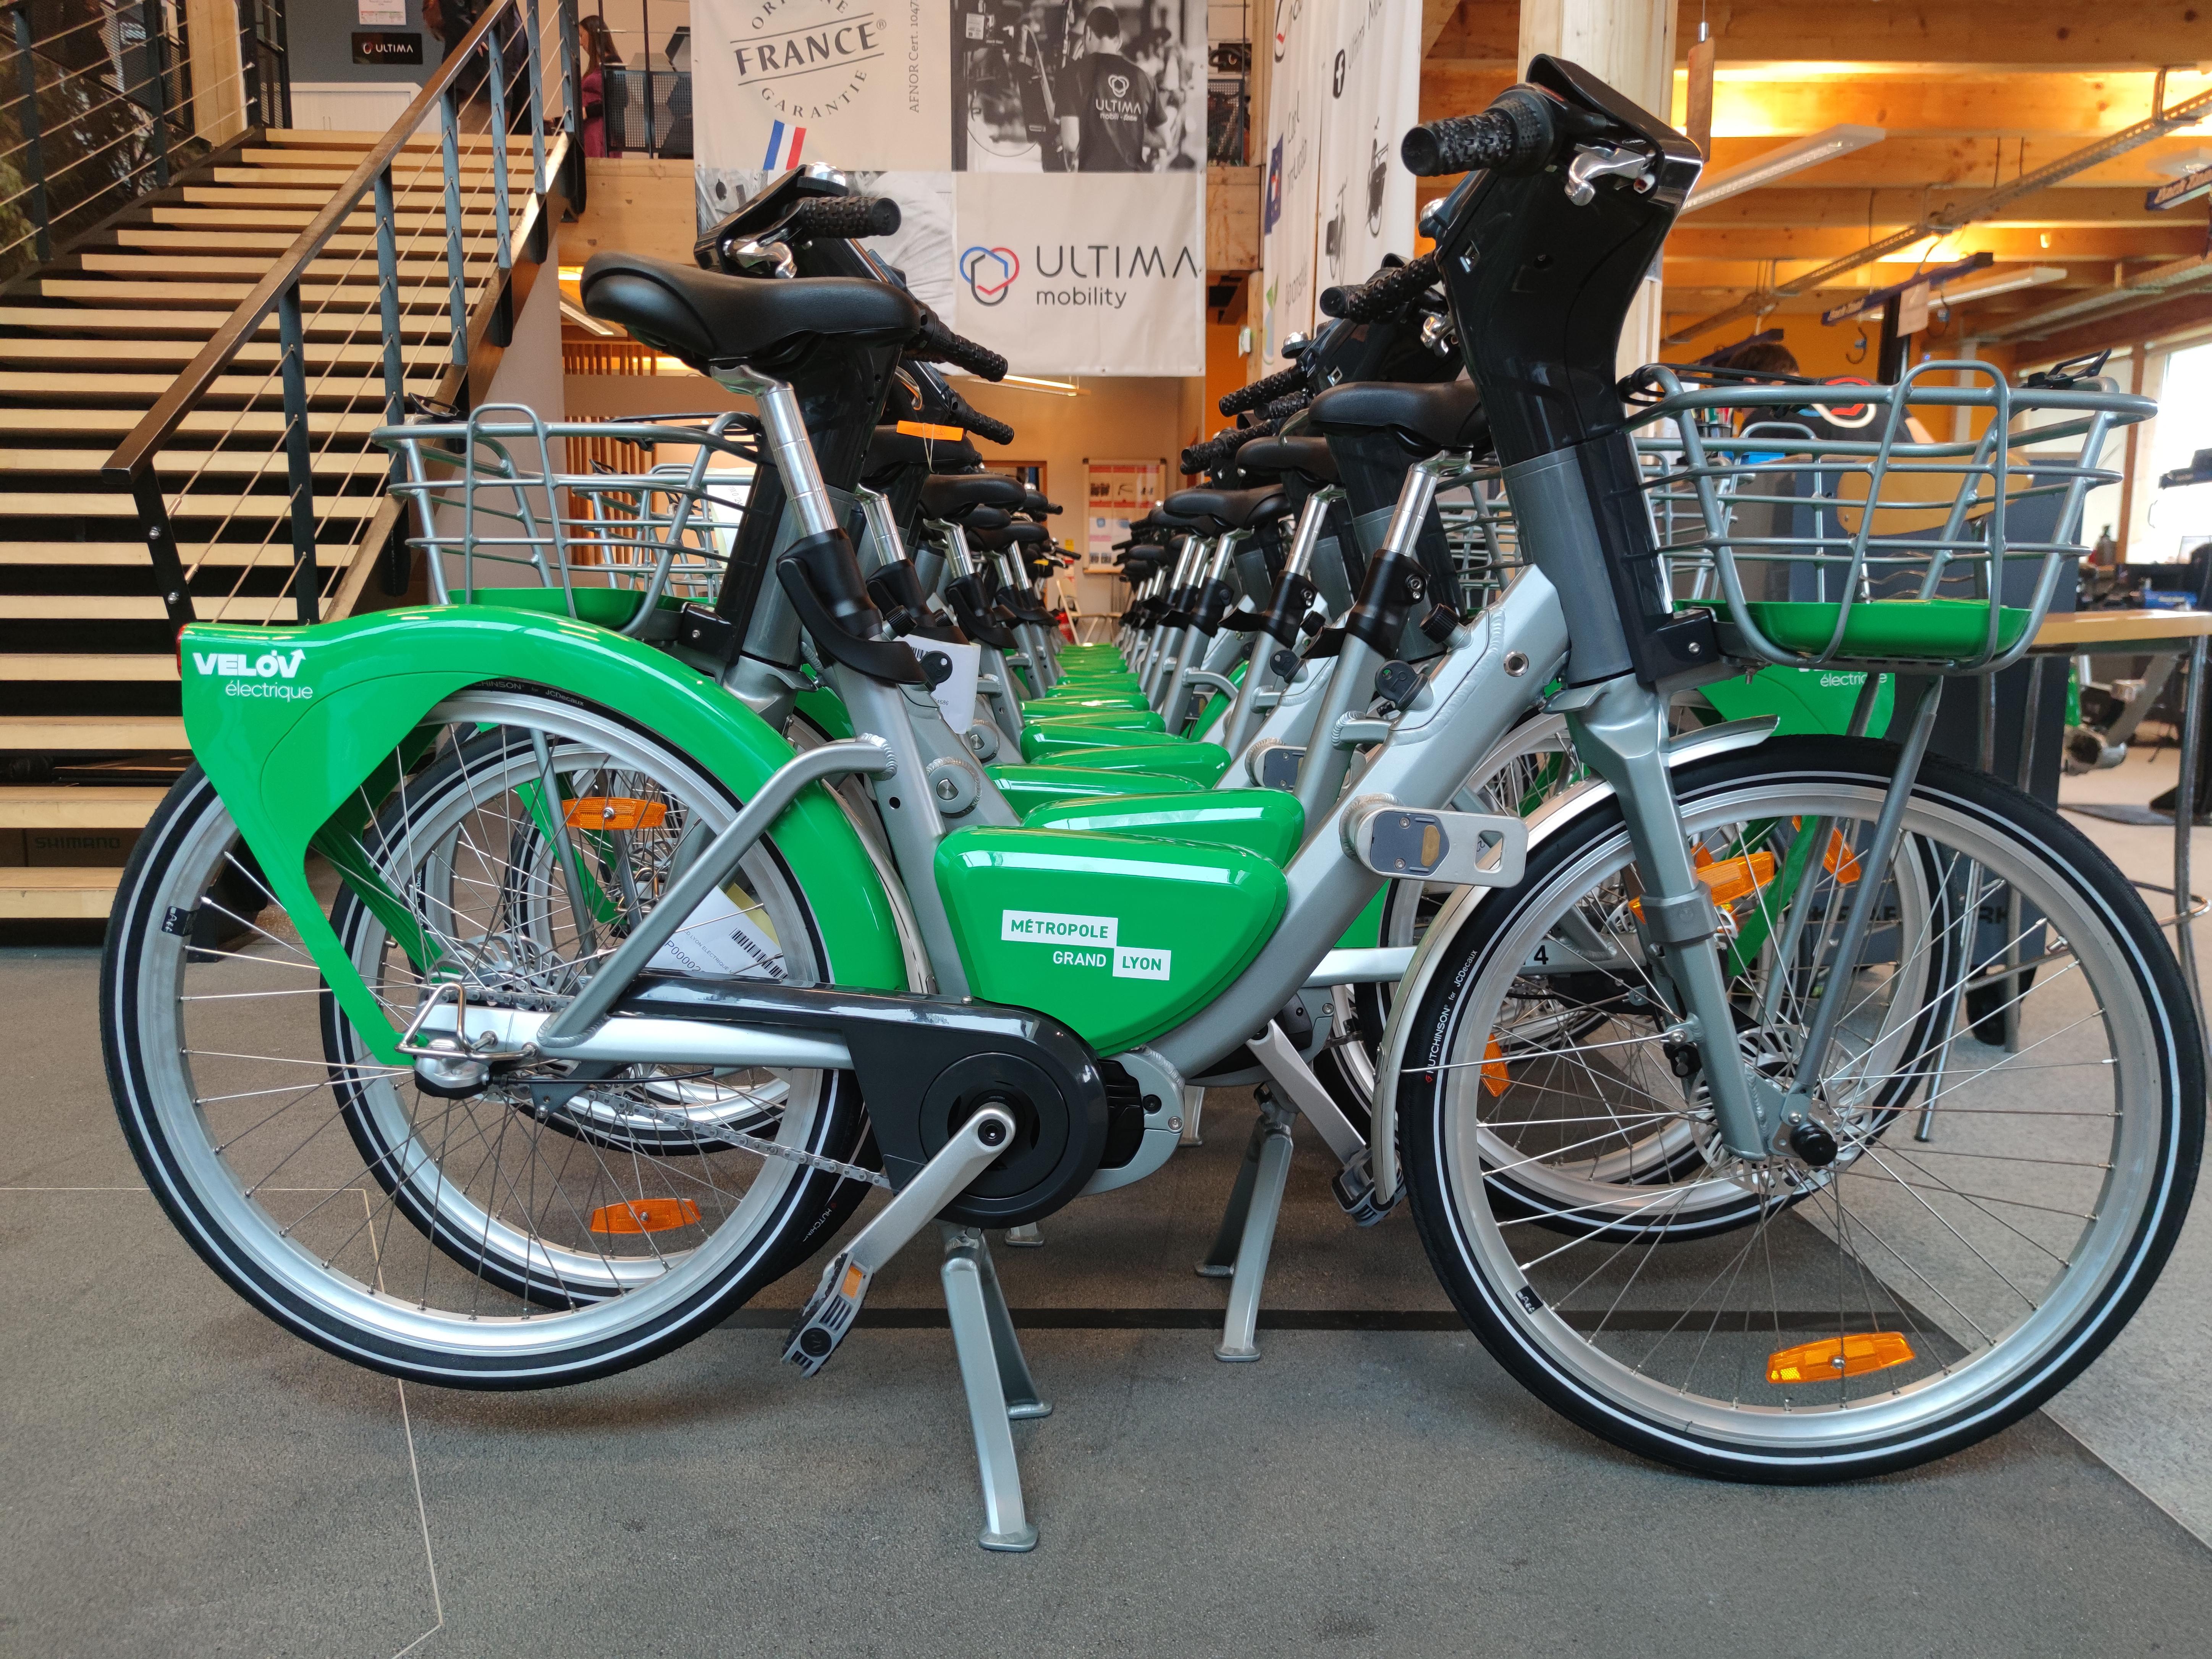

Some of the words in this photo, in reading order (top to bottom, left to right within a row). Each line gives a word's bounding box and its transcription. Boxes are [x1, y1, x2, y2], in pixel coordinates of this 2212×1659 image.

[375, 44, 413, 53] ULTIMA
[909, 31, 918, 61] Cert.
[762, 70, 867, 118] GARANTIE
[909, 64, 919, 113] AFNOR
[1095, 98, 1142, 115] ULTIMA
[1036, 245, 1198, 278] ULTIMA
[1036, 287, 1127, 309] mobility
[225, 680, 313, 703] électrique
[1011, 918, 1109, 939] MÉTROPOLE
[665, 940, 706, 972] P00002
[690, 935, 703, 947] LYON
[701, 945, 729, 971] ELECTRIQUE
[1053, 951, 1106, 967] GRAND
[1122, 956, 1161, 971] LYON
[1448, 992, 1456, 1000] for
[1454, 950, 1478, 987] JCDecaux
